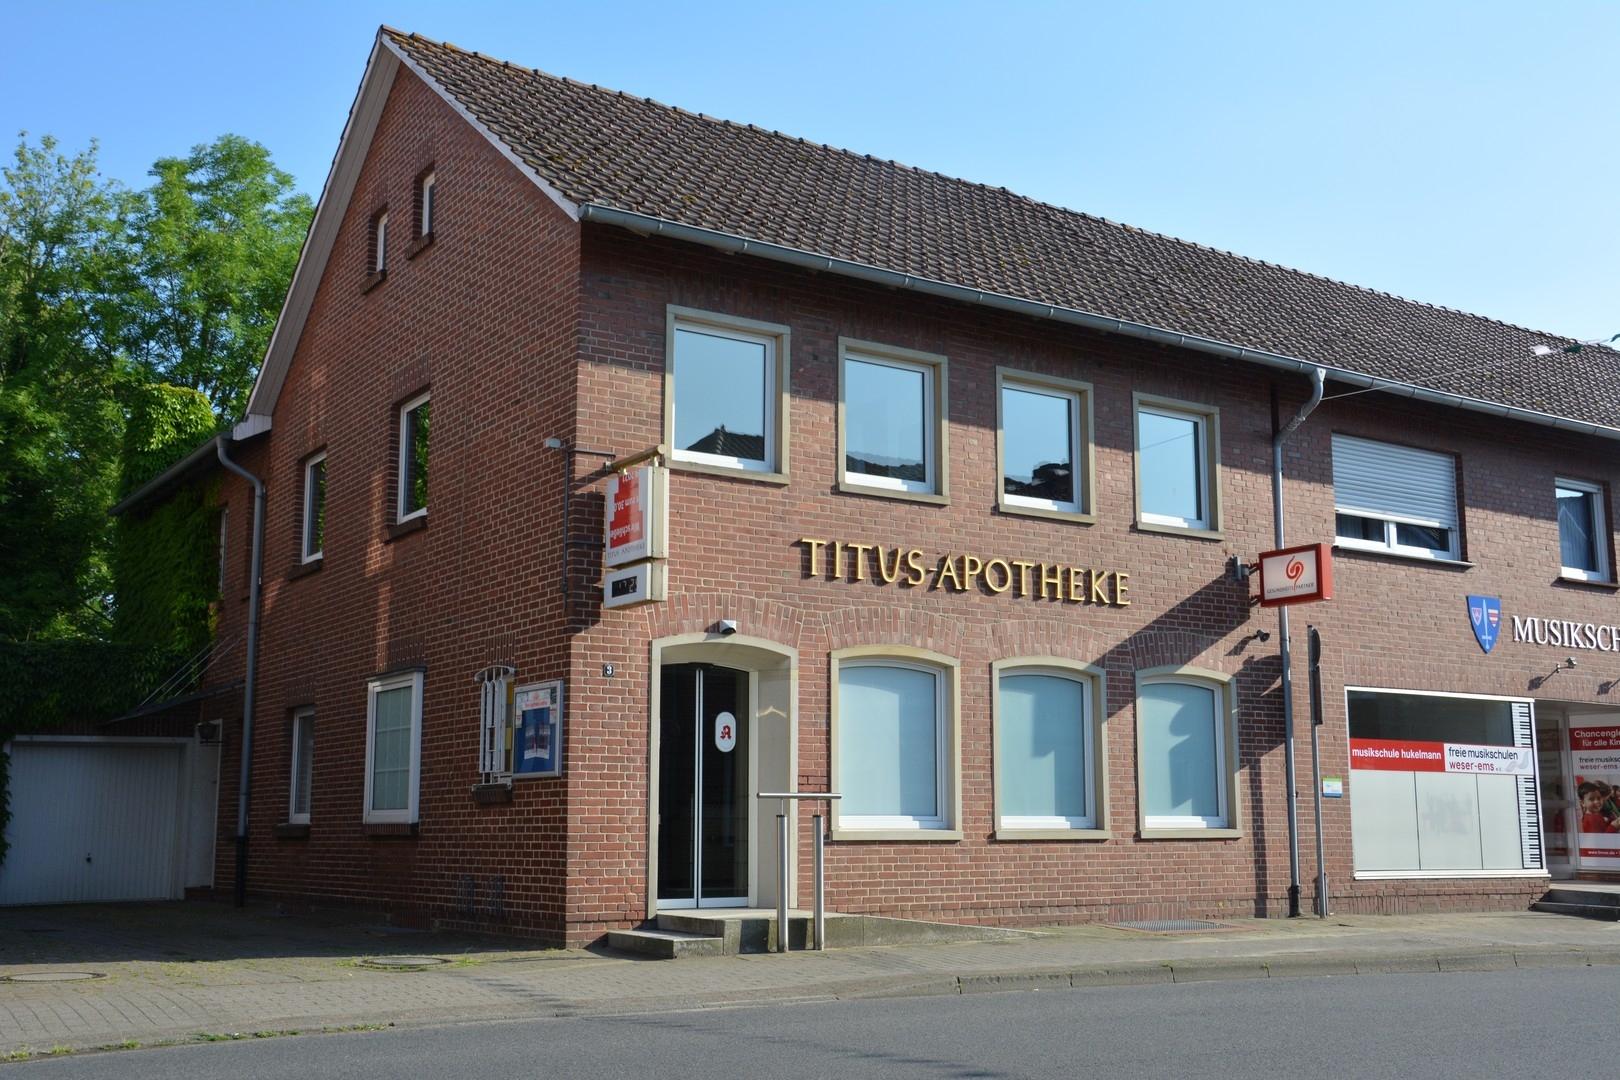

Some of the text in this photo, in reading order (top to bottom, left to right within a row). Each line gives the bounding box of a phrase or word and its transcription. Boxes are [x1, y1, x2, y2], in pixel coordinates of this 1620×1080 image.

[802, 537, 1131, 605] TITUS-APOTHEKE
[1574, 729, 1620, 738] Chancengl
[1352, 748, 1441, 760] musikschule hukelmann
[1448, 746, 1518, 760] freie musikschulen
[1449, 761, 1494, 771] weser-ems
